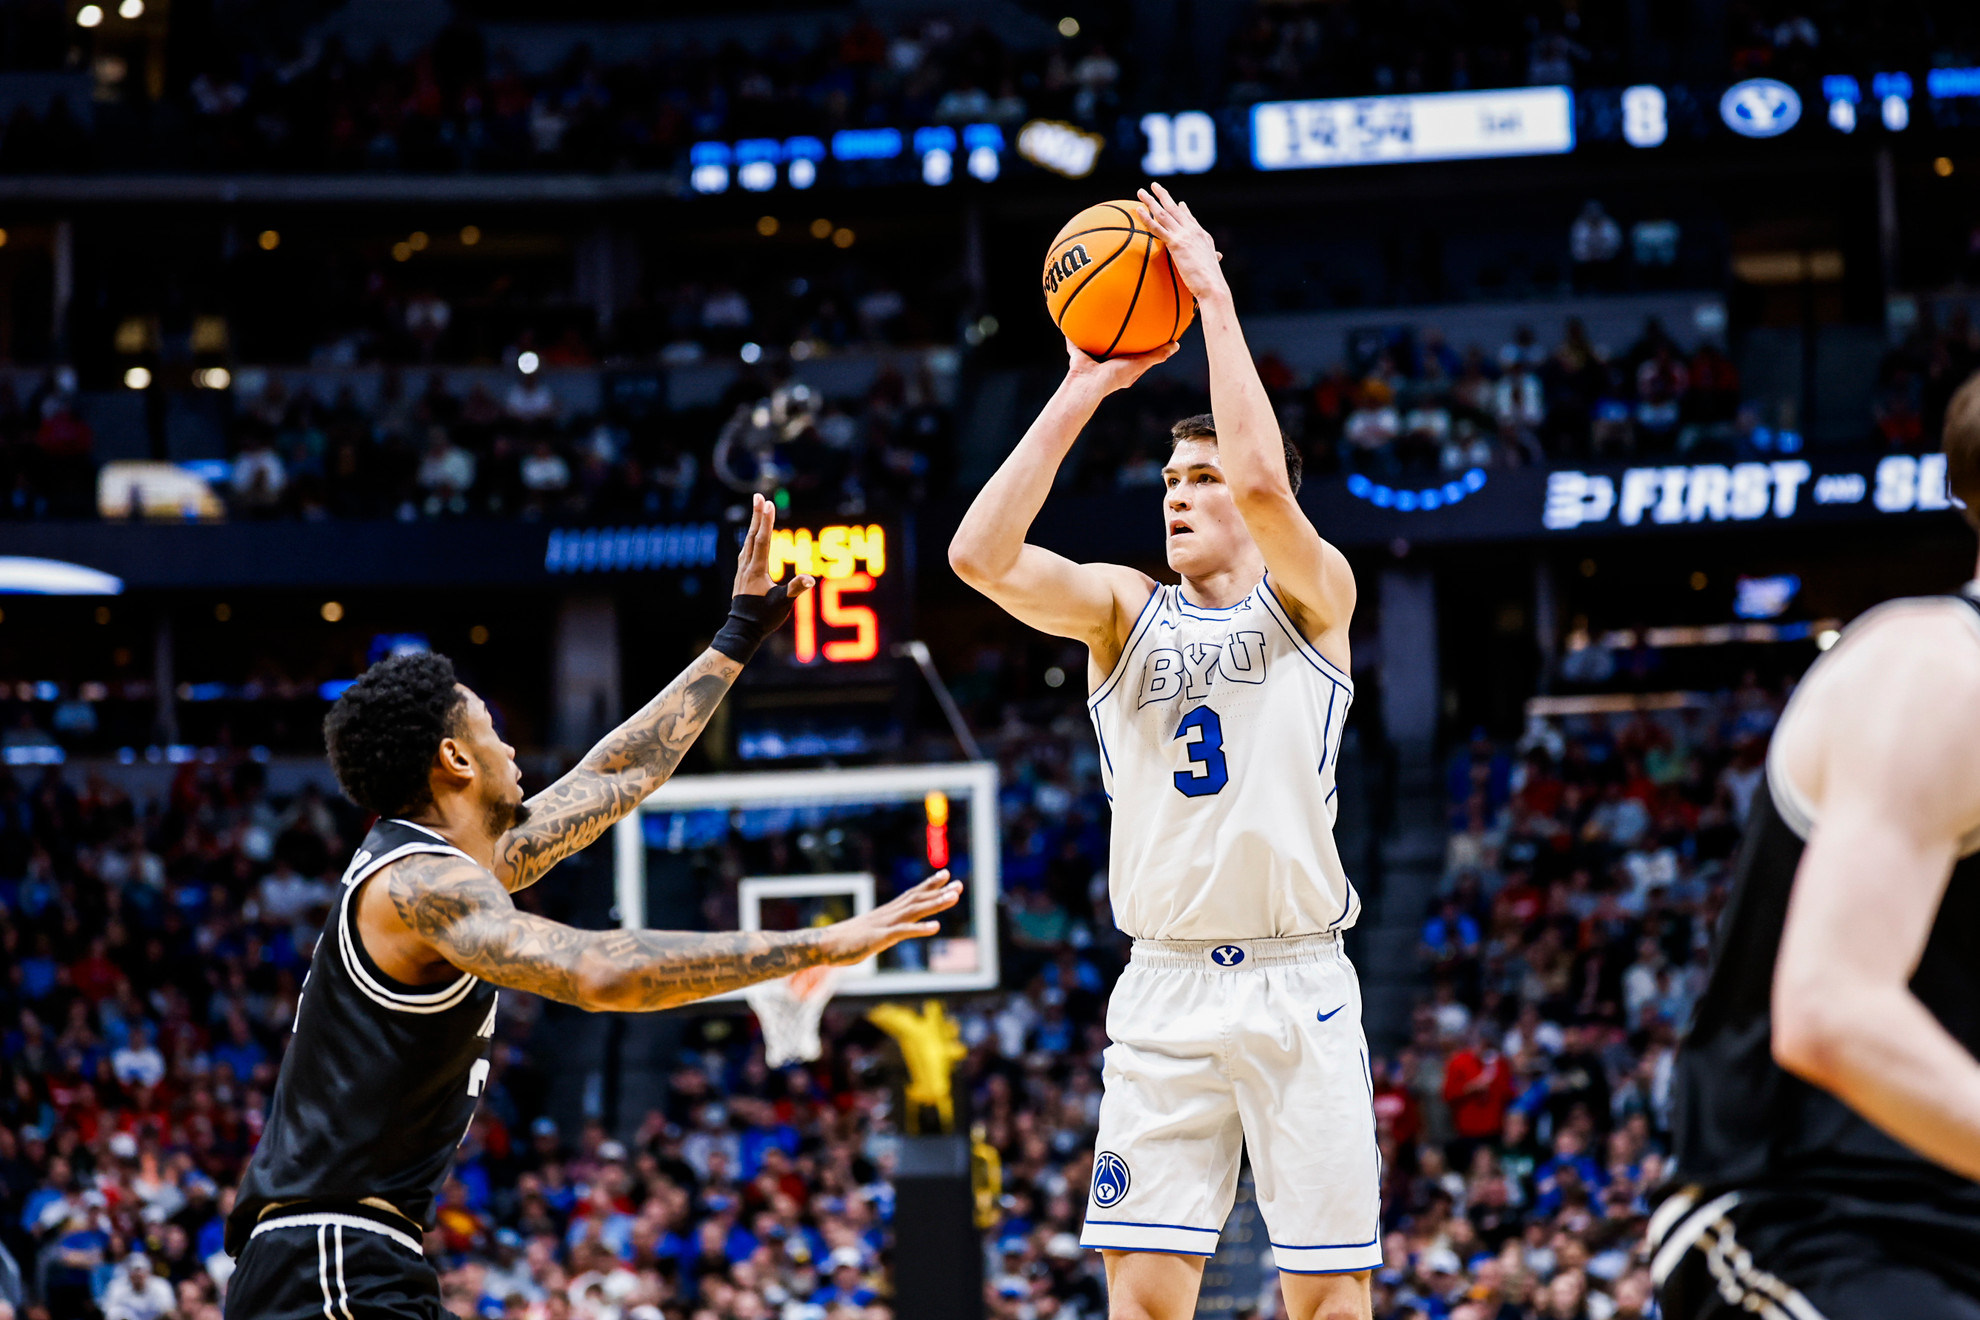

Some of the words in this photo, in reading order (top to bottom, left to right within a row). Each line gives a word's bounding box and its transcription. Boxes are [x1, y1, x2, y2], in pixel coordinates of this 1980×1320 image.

[1140, 110, 1217, 176] 10
[1620, 84, 1668, 149] 8
[1618, 459, 1811, 526] FIRST
[794, 571, 879, 663] 15
[1137, 631, 1267, 710] BYU
[1173, 704, 1229, 798] 3
[1215, 946, 1240, 965] Y
